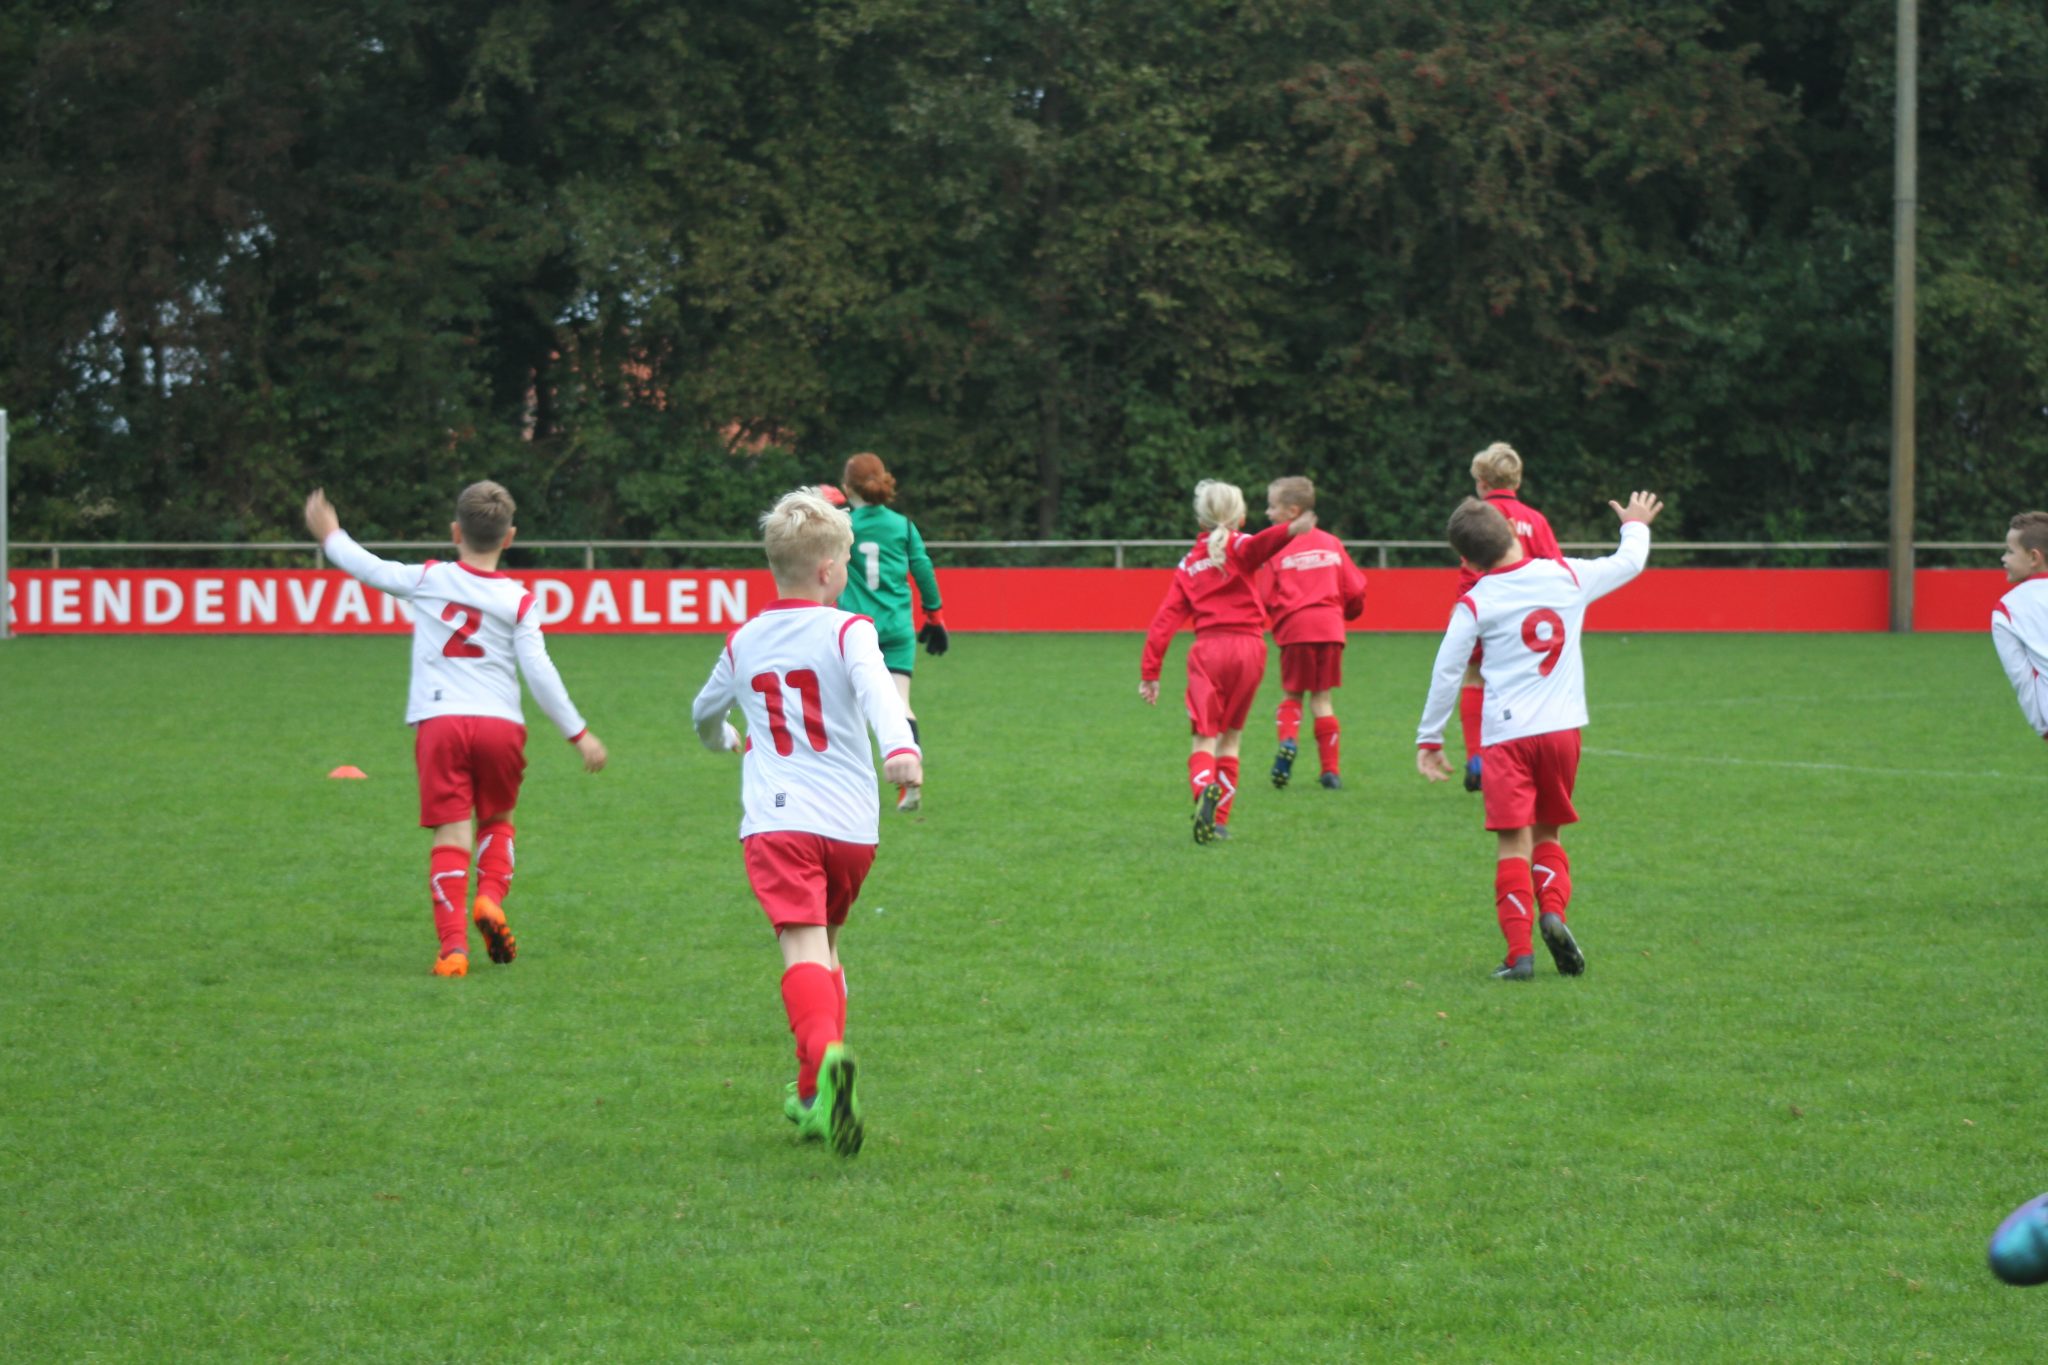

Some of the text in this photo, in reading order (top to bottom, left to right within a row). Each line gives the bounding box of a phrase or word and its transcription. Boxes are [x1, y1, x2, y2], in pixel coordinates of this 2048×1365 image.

[858, 541, 880, 591] 1
[440, 601, 485, 659] 2
[1521, 607, 1565, 678] 9
[751, 668, 828, 757] 11
